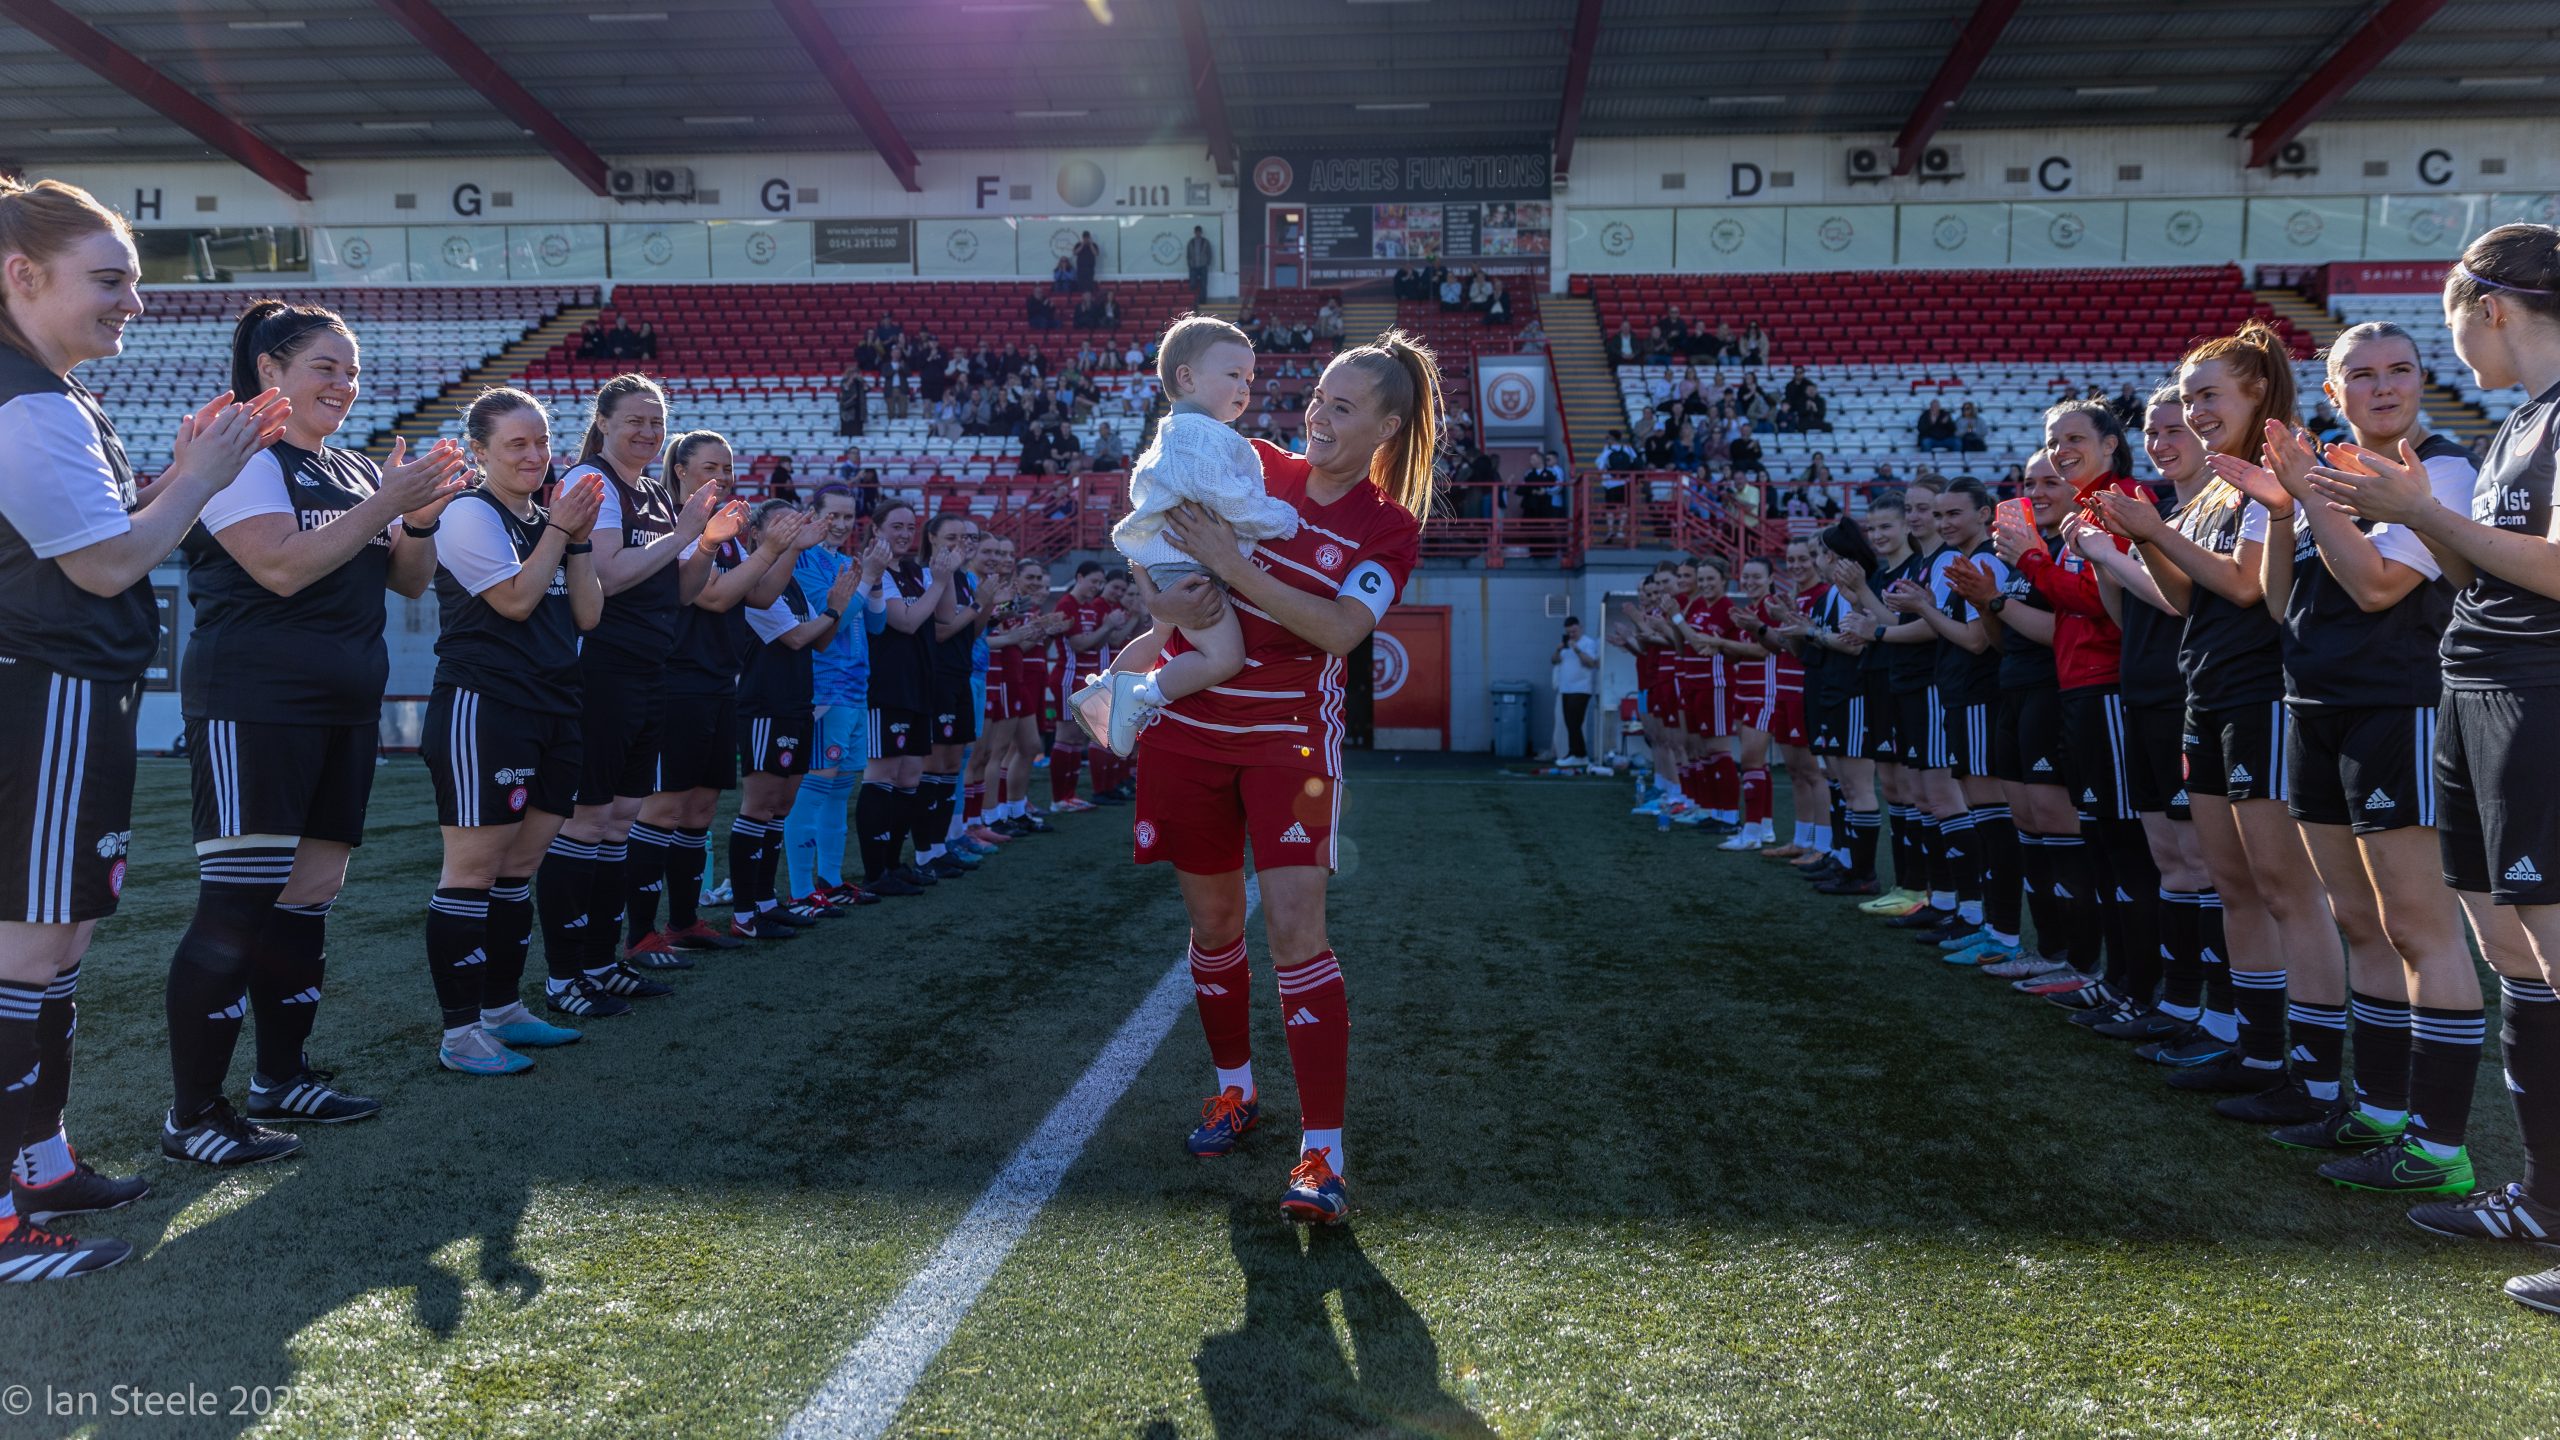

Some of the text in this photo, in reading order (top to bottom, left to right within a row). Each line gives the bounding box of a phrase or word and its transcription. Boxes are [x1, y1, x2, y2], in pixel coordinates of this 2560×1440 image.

[1309, 154, 1547, 192] ACCIES FUNCTIONS
[1731, 163, 1763, 197] D
[2038, 156, 2072, 192] C
[2418, 149, 2453, 185] C
[136, 188, 161, 220] H
[453, 183, 482, 216] G
[761, 178, 791, 212] G
[976, 176, 1000, 208] F
[2501, 485, 2531, 511] 1st
[1358, 571, 1382, 595] C
[2229, 775, 2253, 783] adidas
[2365, 800, 2395, 810] adidas
[1280, 834, 1311, 844] adidas
[2504, 870, 2542, 881] adidas
